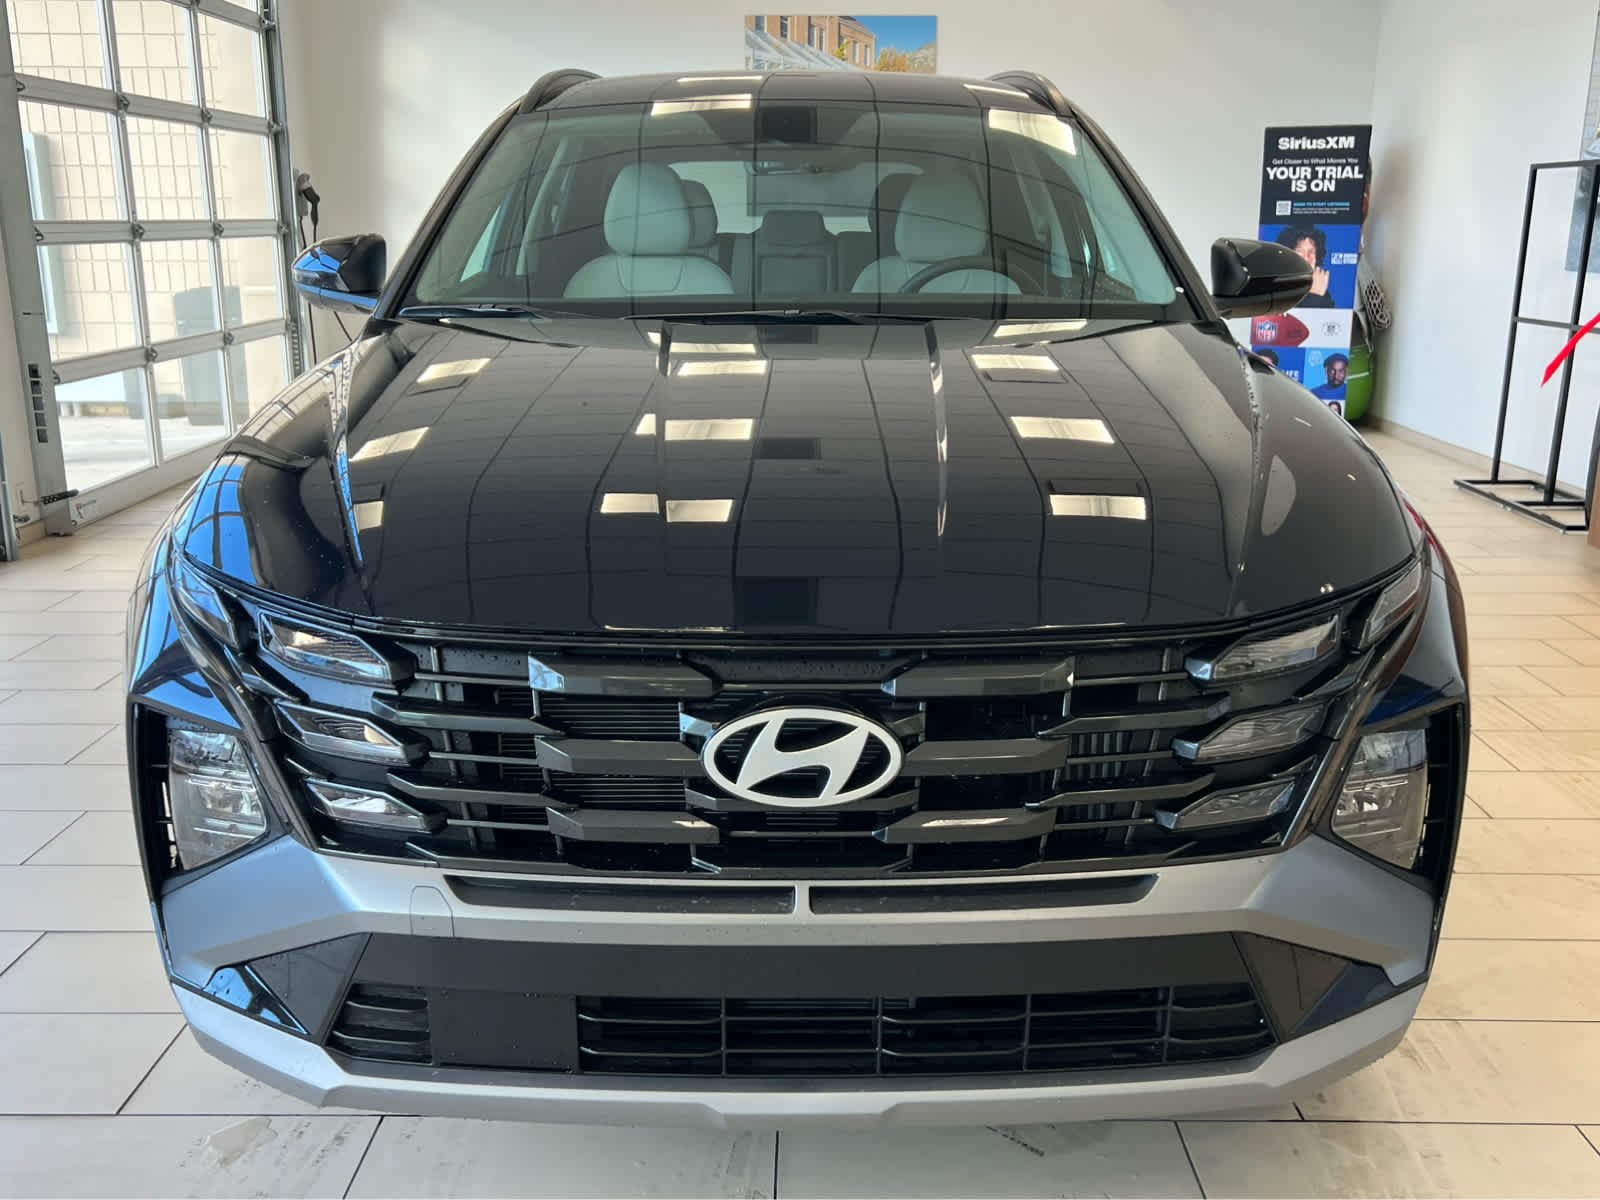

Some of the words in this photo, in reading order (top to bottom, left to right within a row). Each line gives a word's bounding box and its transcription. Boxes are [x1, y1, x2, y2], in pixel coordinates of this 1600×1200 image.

[1278, 136, 1355, 150] SiriusXM
[1266, 166, 1312, 180] YOUR
[1315, 165, 1364, 179] TRIAL
[1291, 179, 1307, 192] IS
[1310, 179, 1336, 192] ON
